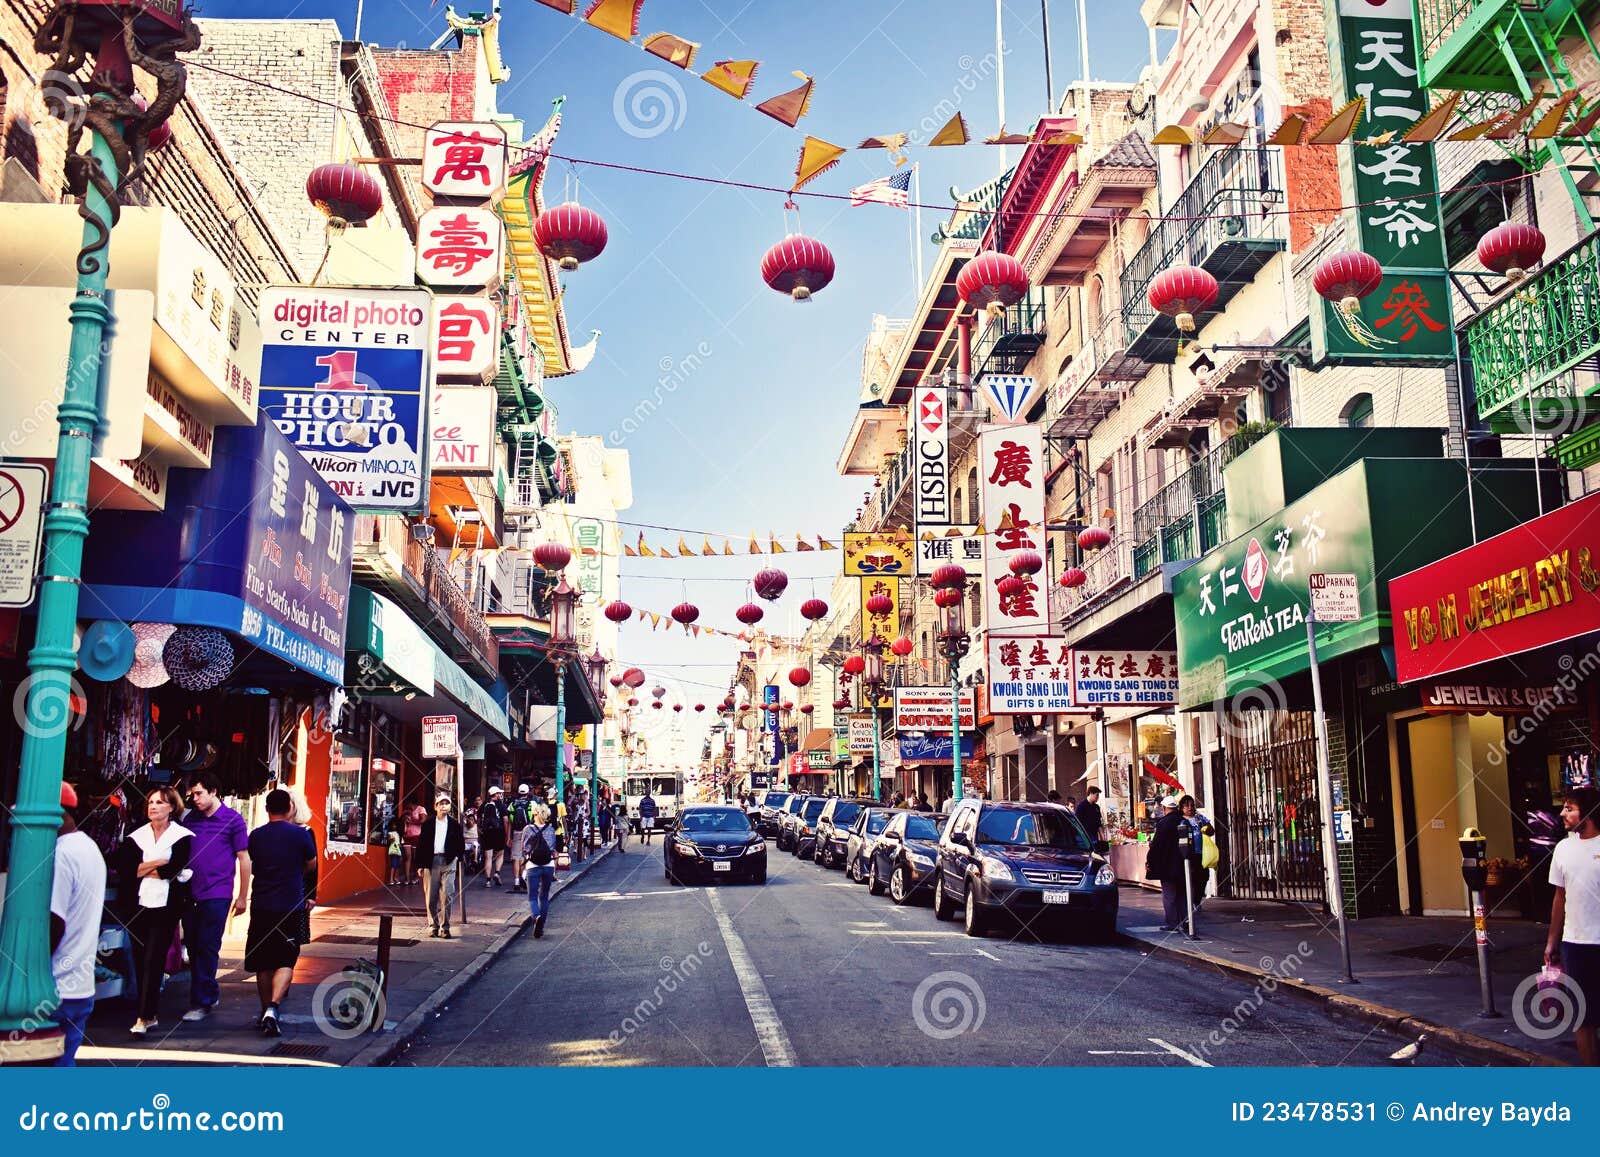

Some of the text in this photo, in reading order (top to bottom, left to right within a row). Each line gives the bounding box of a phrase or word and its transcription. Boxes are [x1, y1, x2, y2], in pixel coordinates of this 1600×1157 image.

[274, 298, 424, 328] digital photo
[1374, 280, 1447, 342] 參
[280, 329, 410, 345] CENTER
[315, 350, 368, 392] 1
[281, 393, 397, 422] HOUR
[311, 457, 358, 473] Nikon
[920, 440, 945, 518] HSBC
[372, 480, 414, 497] JVC
[923, 539, 982, 561] 匯豐
[1311, 575, 1355, 587] NO PARKING
[1463, 549, 1573, 633] JEWELRY
[245, 563, 265, 600] Fine
[319, 611, 341, 649] Purses
[1275, 602, 1304, 634] TEA
[993, 682, 1023, 697] KWONG
[1026, 682, 1049, 697] SANG
[1077, 680, 1112, 691] KWONG
[1114, 680, 1140, 690] SANG
[1142, 680, 1167, 690] TONG
[1007, 699, 1034, 708] GIFTS
[1038, 699, 1045, 708] &
[1087, 691, 1174, 702] GIFTS & HERBS
[1430, 685, 1509, 706] JEWELRY
[898, 714, 973, 726] SOUVENRS
[424, 724, 433, 733] NO
[432, 742, 448, 750] TIME
[433, 734, 446, 742] ANY
